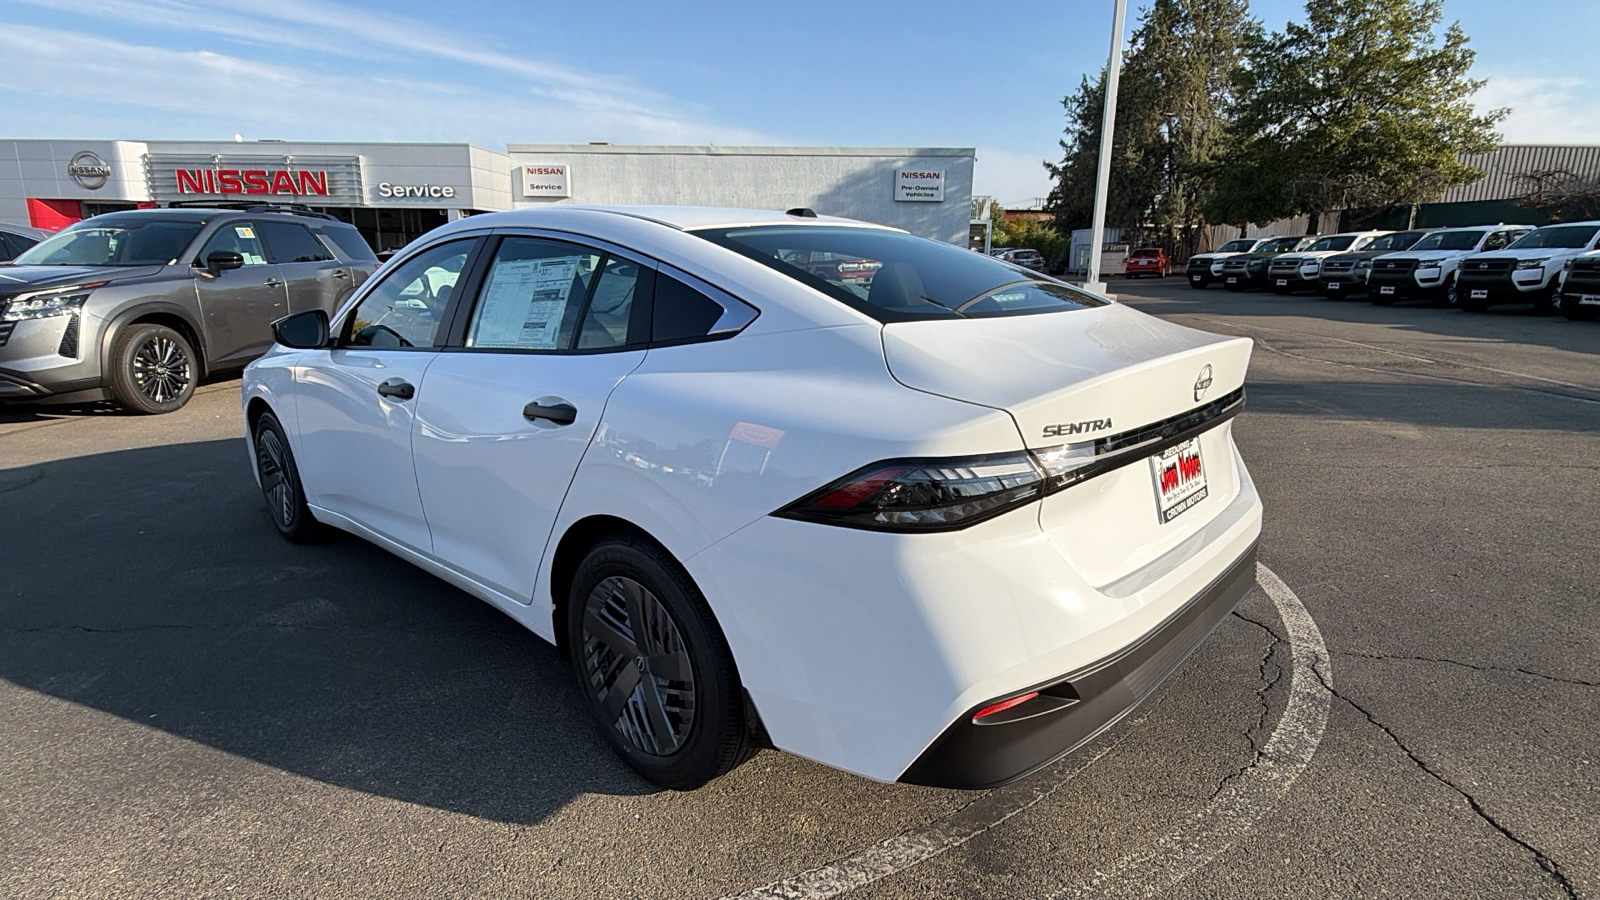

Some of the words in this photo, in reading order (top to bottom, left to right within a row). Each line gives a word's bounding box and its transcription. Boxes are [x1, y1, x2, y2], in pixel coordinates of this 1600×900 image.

[71, 166, 105, 174] NISSAN
[526, 167, 564, 175] NISSAN
[175, 169, 329, 195] NISSAN
[378, 182, 454, 198] Service
[1042, 418, 1112, 437] SENTRA
[1166, 501, 1187, 520] CROWN
[1186, 488, 1207, 507] MOTORS
